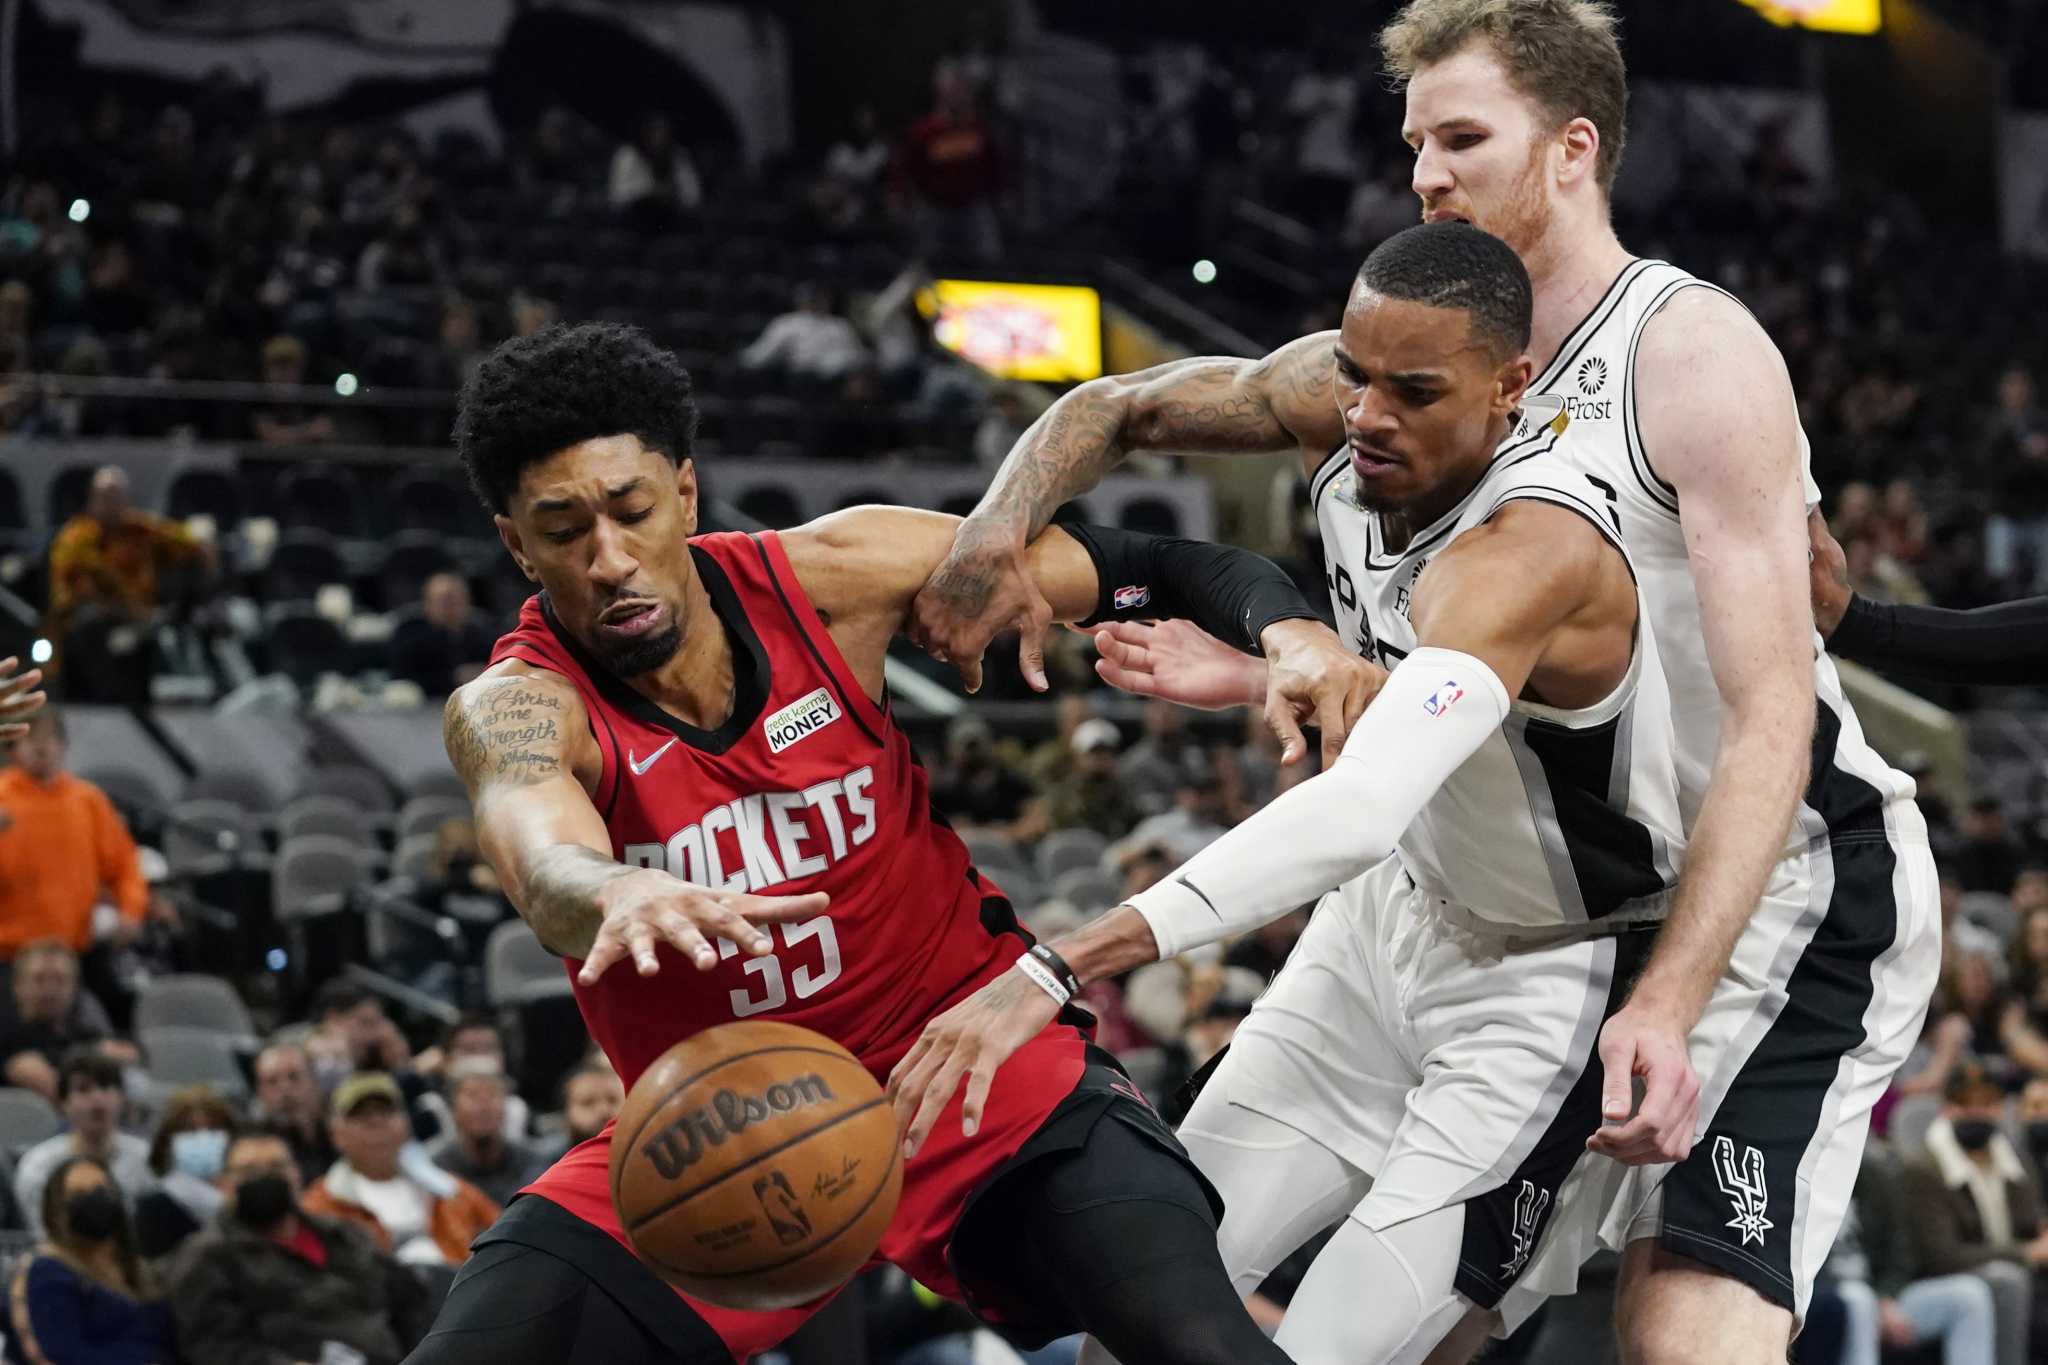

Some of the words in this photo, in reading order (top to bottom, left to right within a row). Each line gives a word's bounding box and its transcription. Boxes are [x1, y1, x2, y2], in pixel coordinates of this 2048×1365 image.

[1566, 396, 1612, 420] Frost
[766, 710, 794, 733] credit
[791, 692, 829, 717] karma
[770, 702, 833, 750] MONEY
[625, 766, 877, 894] OCKETS
[717, 914, 842, 1018] 35
[642, 1073, 832, 1180] Wilson
